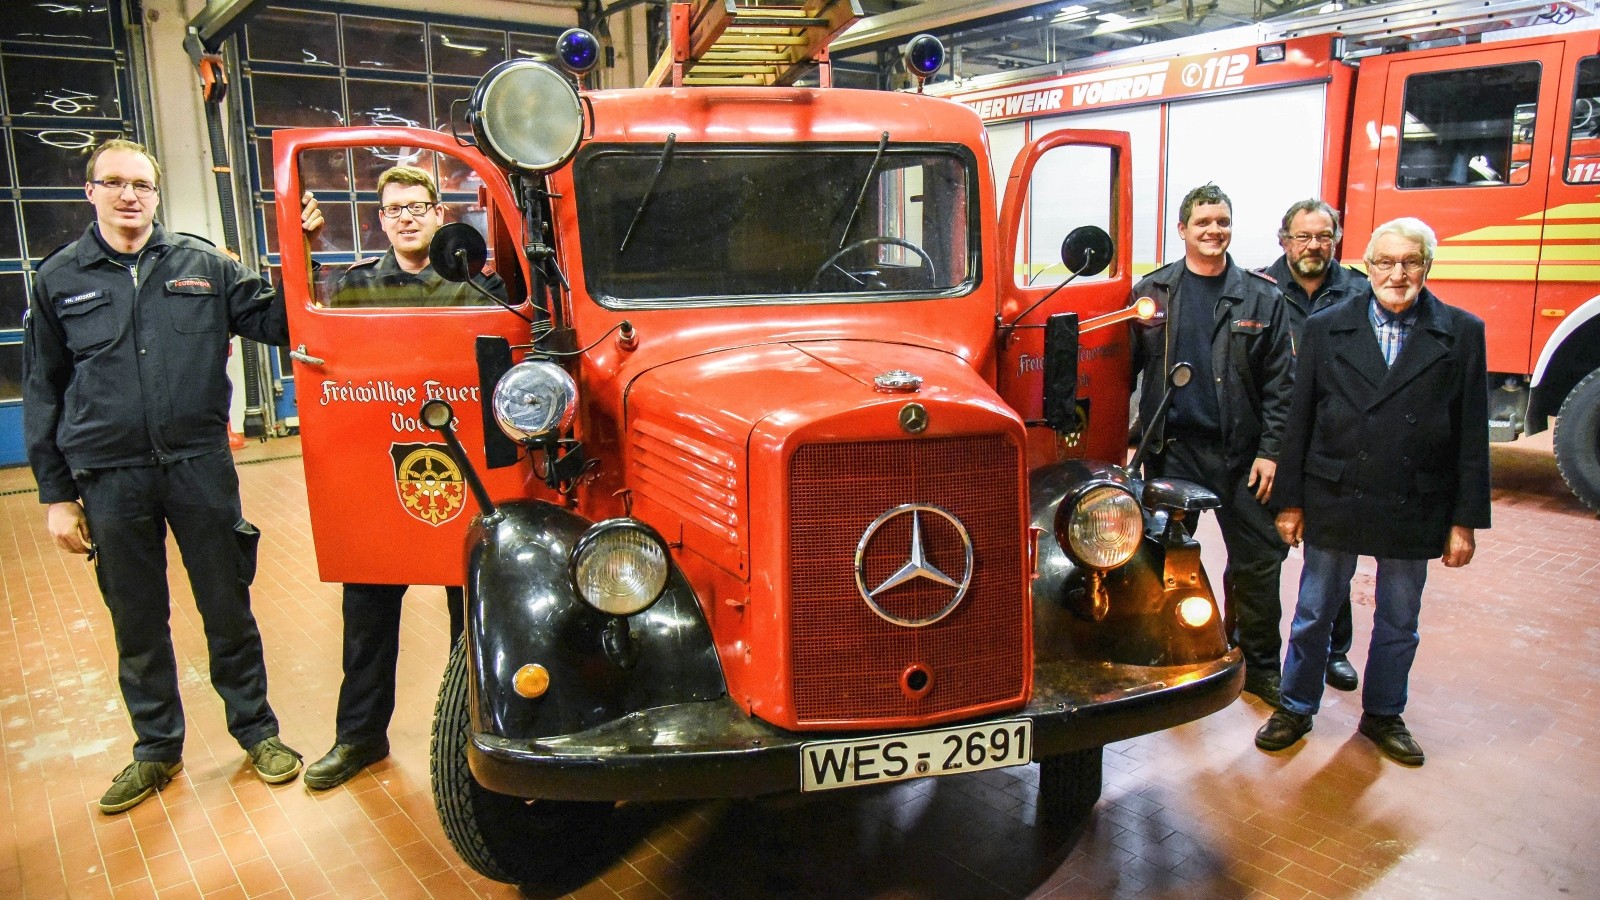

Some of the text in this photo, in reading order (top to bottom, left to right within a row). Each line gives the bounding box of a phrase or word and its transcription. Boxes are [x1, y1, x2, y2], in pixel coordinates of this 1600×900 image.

[1072, 73, 1167, 106] VOERDE
[1201, 53, 1250, 89] 112
[320, 380, 417, 406] Freiwillige
[391, 412, 460, 433] Voee
